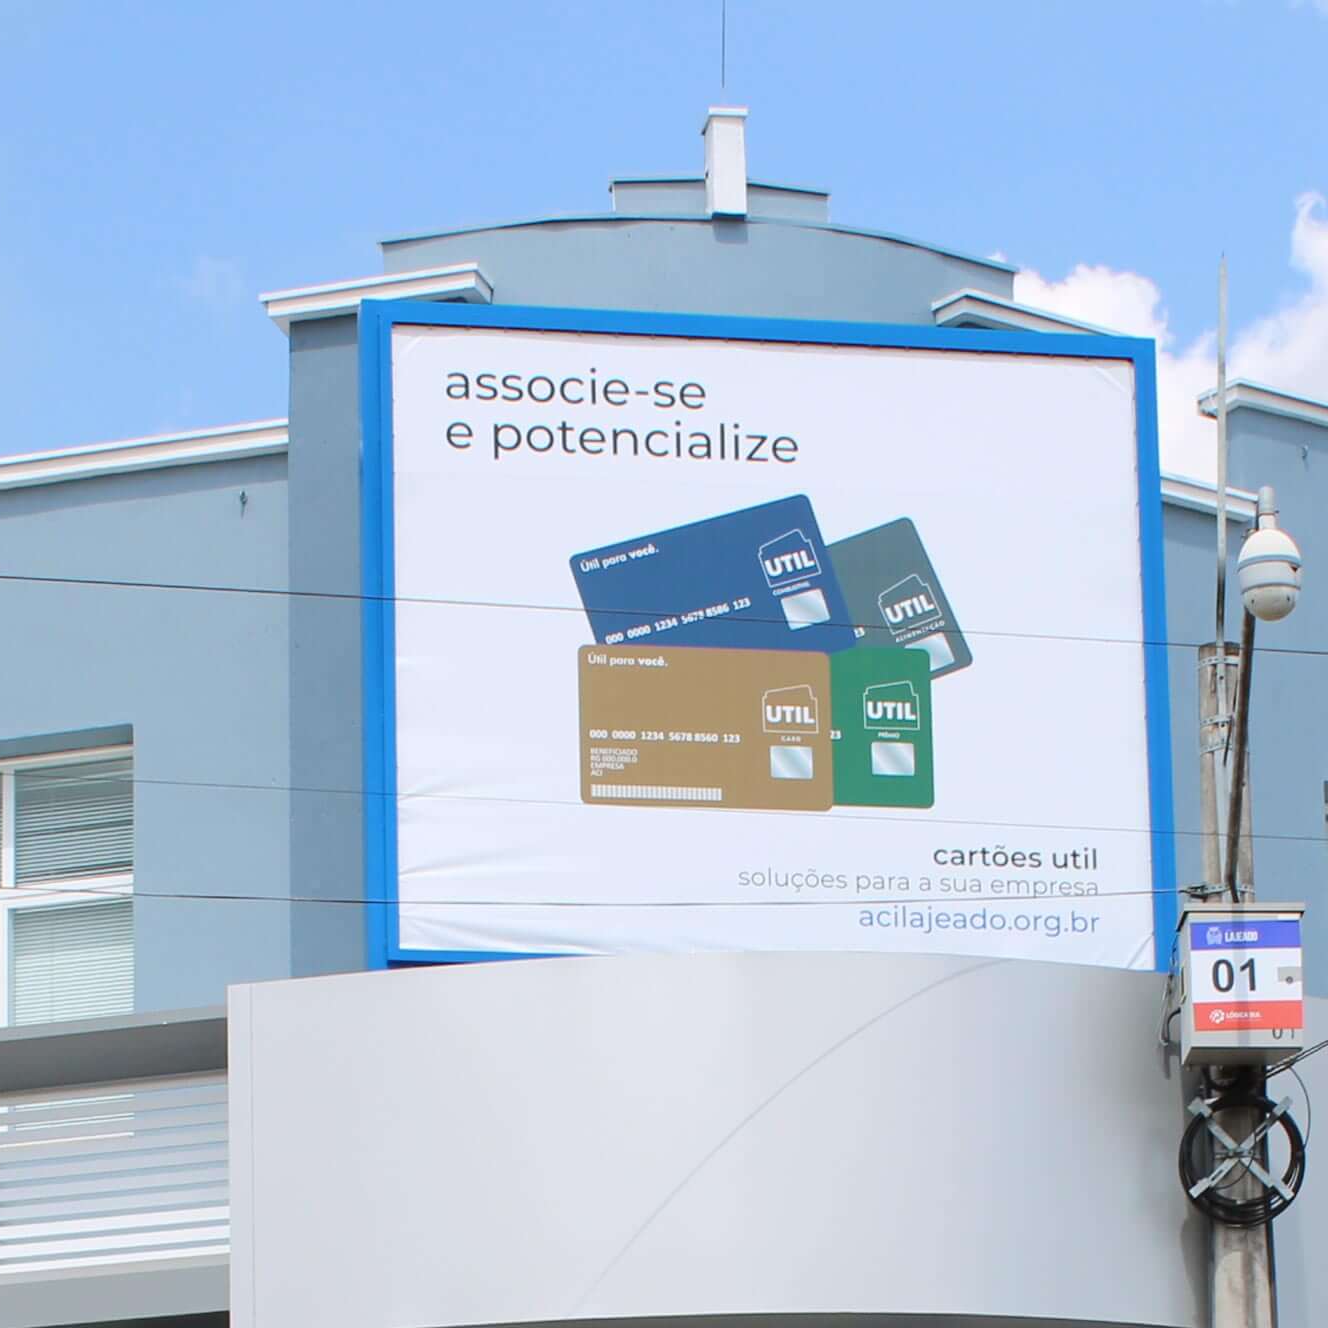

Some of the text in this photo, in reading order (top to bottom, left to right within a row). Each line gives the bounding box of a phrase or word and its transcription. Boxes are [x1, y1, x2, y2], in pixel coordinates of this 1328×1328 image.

[445, 367, 707, 410] associe-se
[445, 420, 800, 464] e potencialize
[764, 549, 817, 578] UTIL
[653, 616, 679, 633] 1234
[732, 597, 752, 612] 123
[884, 593, 935, 624] UTIL
[765, 704, 816, 724] UTIL
[866, 700, 917, 721] UTIL
[589, 729, 608, 740] 000
[611, 729, 637, 740] 0000
[640, 730, 665, 742] 1234
[668, 731, 692, 743] 5678
[723, 733, 741, 744] 123
[932, 844, 1098, 871] cartões util
[737, 867, 1100, 899] soluções para a sua empresa
[858, 904, 1101, 938] acilajeado.org.br
[1211, 957, 1257, 993] 01
